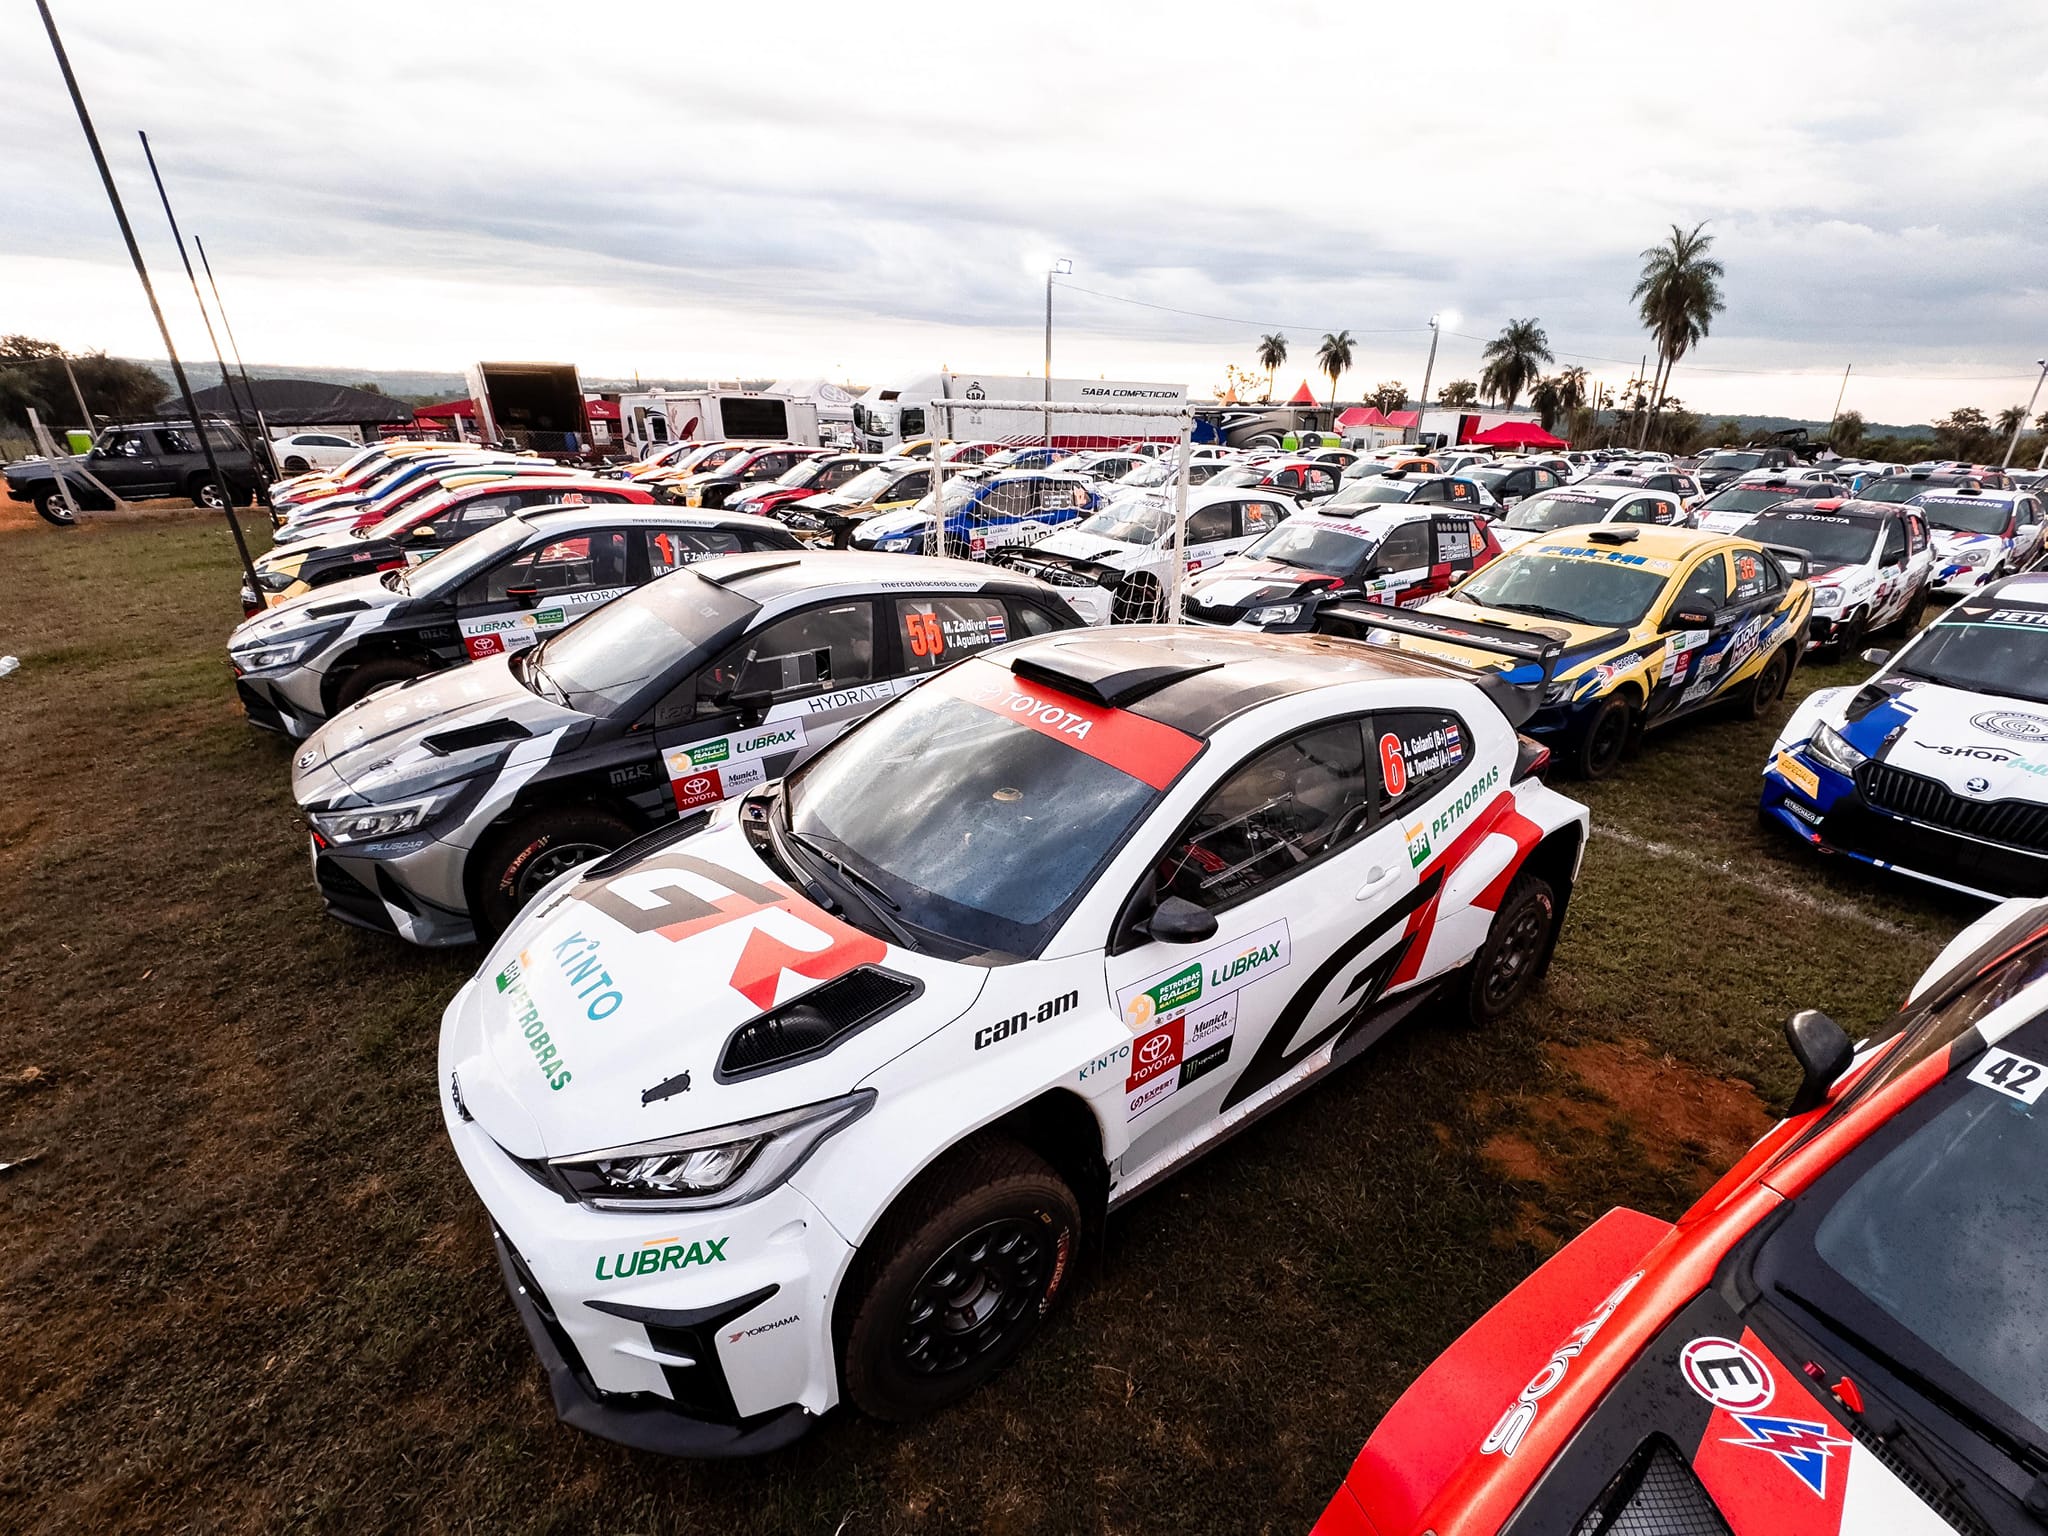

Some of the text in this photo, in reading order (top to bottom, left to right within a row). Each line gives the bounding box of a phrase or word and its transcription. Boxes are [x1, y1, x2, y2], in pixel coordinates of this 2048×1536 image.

[1082, 388, 1179, 398] SABA COMPETICION
[1655, 502, 1668, 513] 75
[1805, 514, 1850, 524] TOYOTA
[654, 533, 673, 565] 1
[1740, 557, 1756, 580] 33
[570, 589, 623, 604] HYDRA
[881, 580, 978, 589] mercatolacaoba.com
[468, 620, 516, 635] LUBRAX
[905, 612, 945, 657] 55
[473, 648, 500, 657] TOYOTA
[808, 684, 889, 712] HYDRATE
[1000, 691, 1093, 740] TOYOTA
[737, 730, 797, 753] LUBRAX
[1937, 745, 2009, 762] SHOP
[728, 769, 758, 782] Munich
[1380, 733, 1407, 796] 6
[682, 791, 718, 805] TOYOTA
[1432, 766, 1499, 839] PETROBRAS
[1211, 940, 1281, 987] LUBRAX
[1159, 979, 1200, 1003] RALLY
[1160, 970, 1200, 994] PETROBRAS
[974, 990, 1079, 1051] can-am
[1191, 1021, 1228, 1043] ORIGINAL
[1193, 1010, 1228, 1034] Munich
[508, 983, 572, 1091] PETROBRAS
[1133, 1053, 1176, 1081] TOYOTA
[1983, 1055, 2042, 1095] 42
[1143, 1078, 1175, 1101] EXPERT
[595, 1236, 730, 1281] LUBRAX
[745, 1314, 801, 1338] YOKOHAMA
